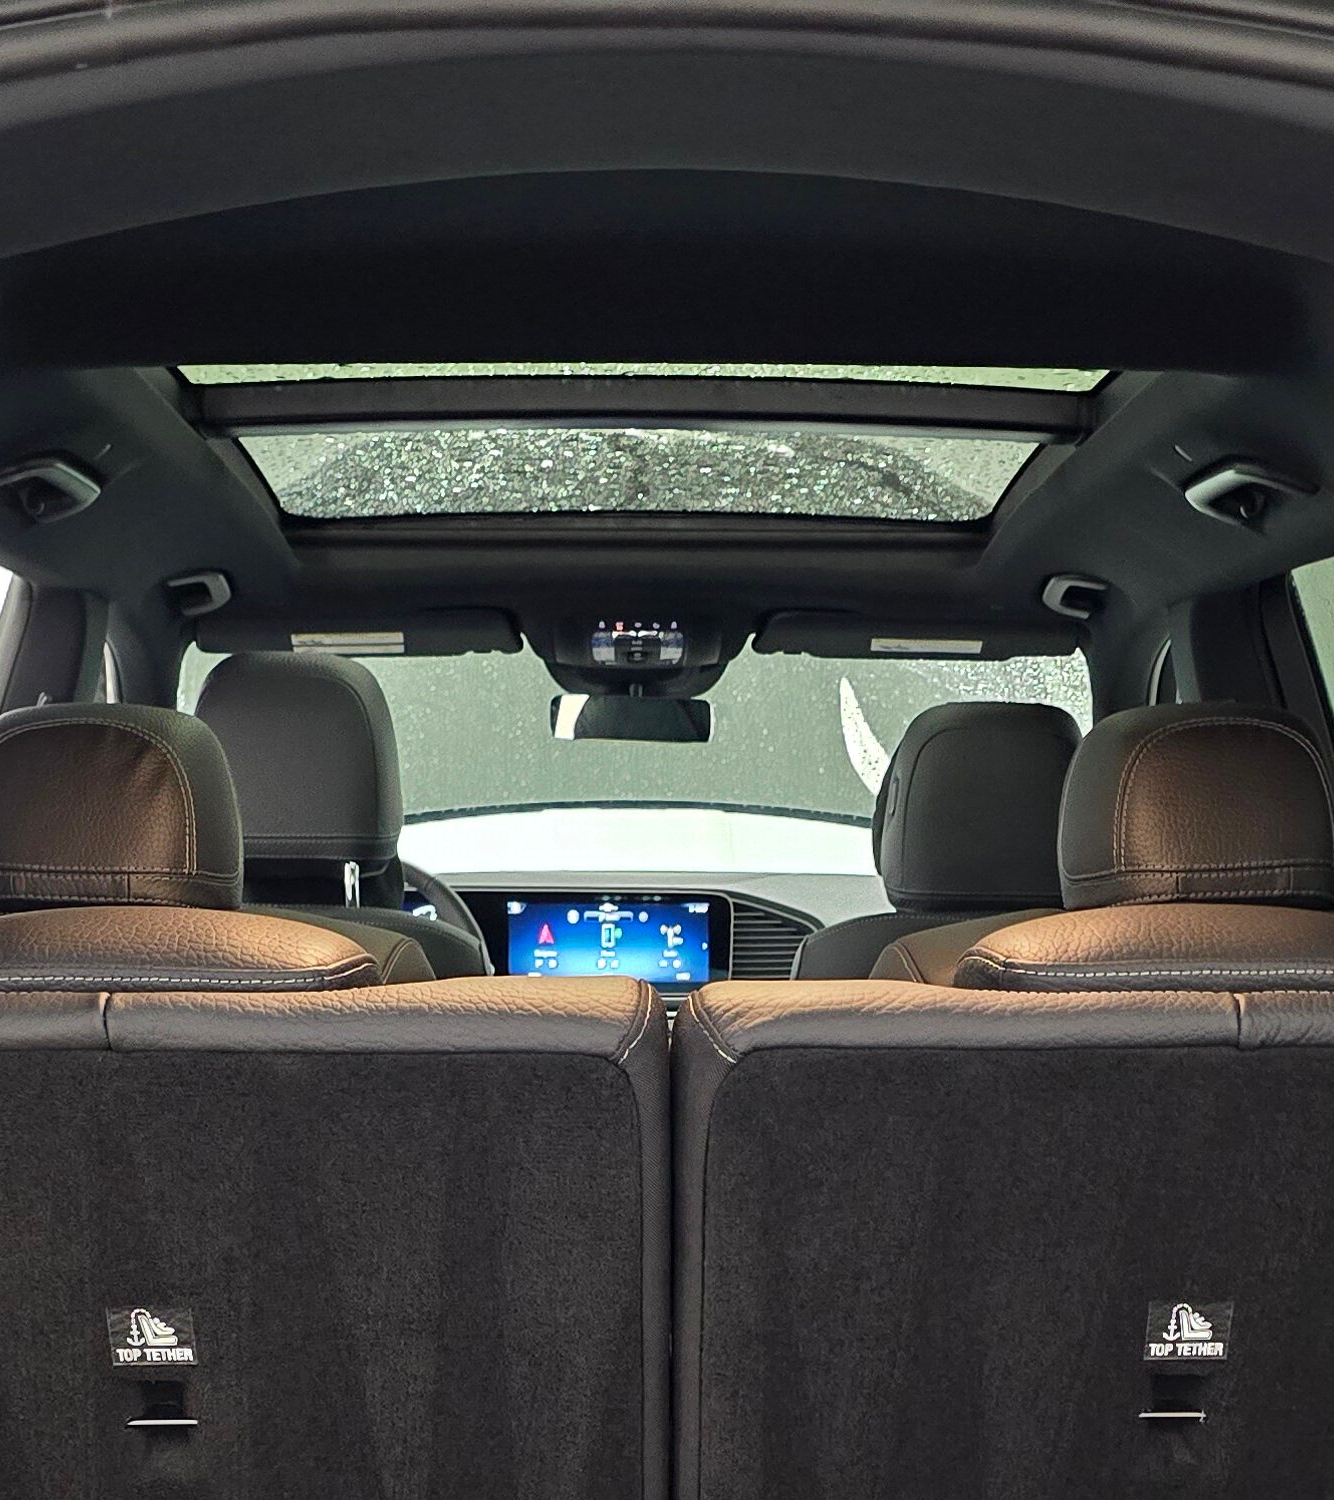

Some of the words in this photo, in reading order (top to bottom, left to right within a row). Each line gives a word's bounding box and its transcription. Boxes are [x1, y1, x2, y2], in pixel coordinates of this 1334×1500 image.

[115, 1348, 142, 1362] TOP
[143, 1348, 194, 1361] TETHER
[1148, 1342, 1174, 1357] TOP
[1175, 1342, 1224, 1357] TETHER
